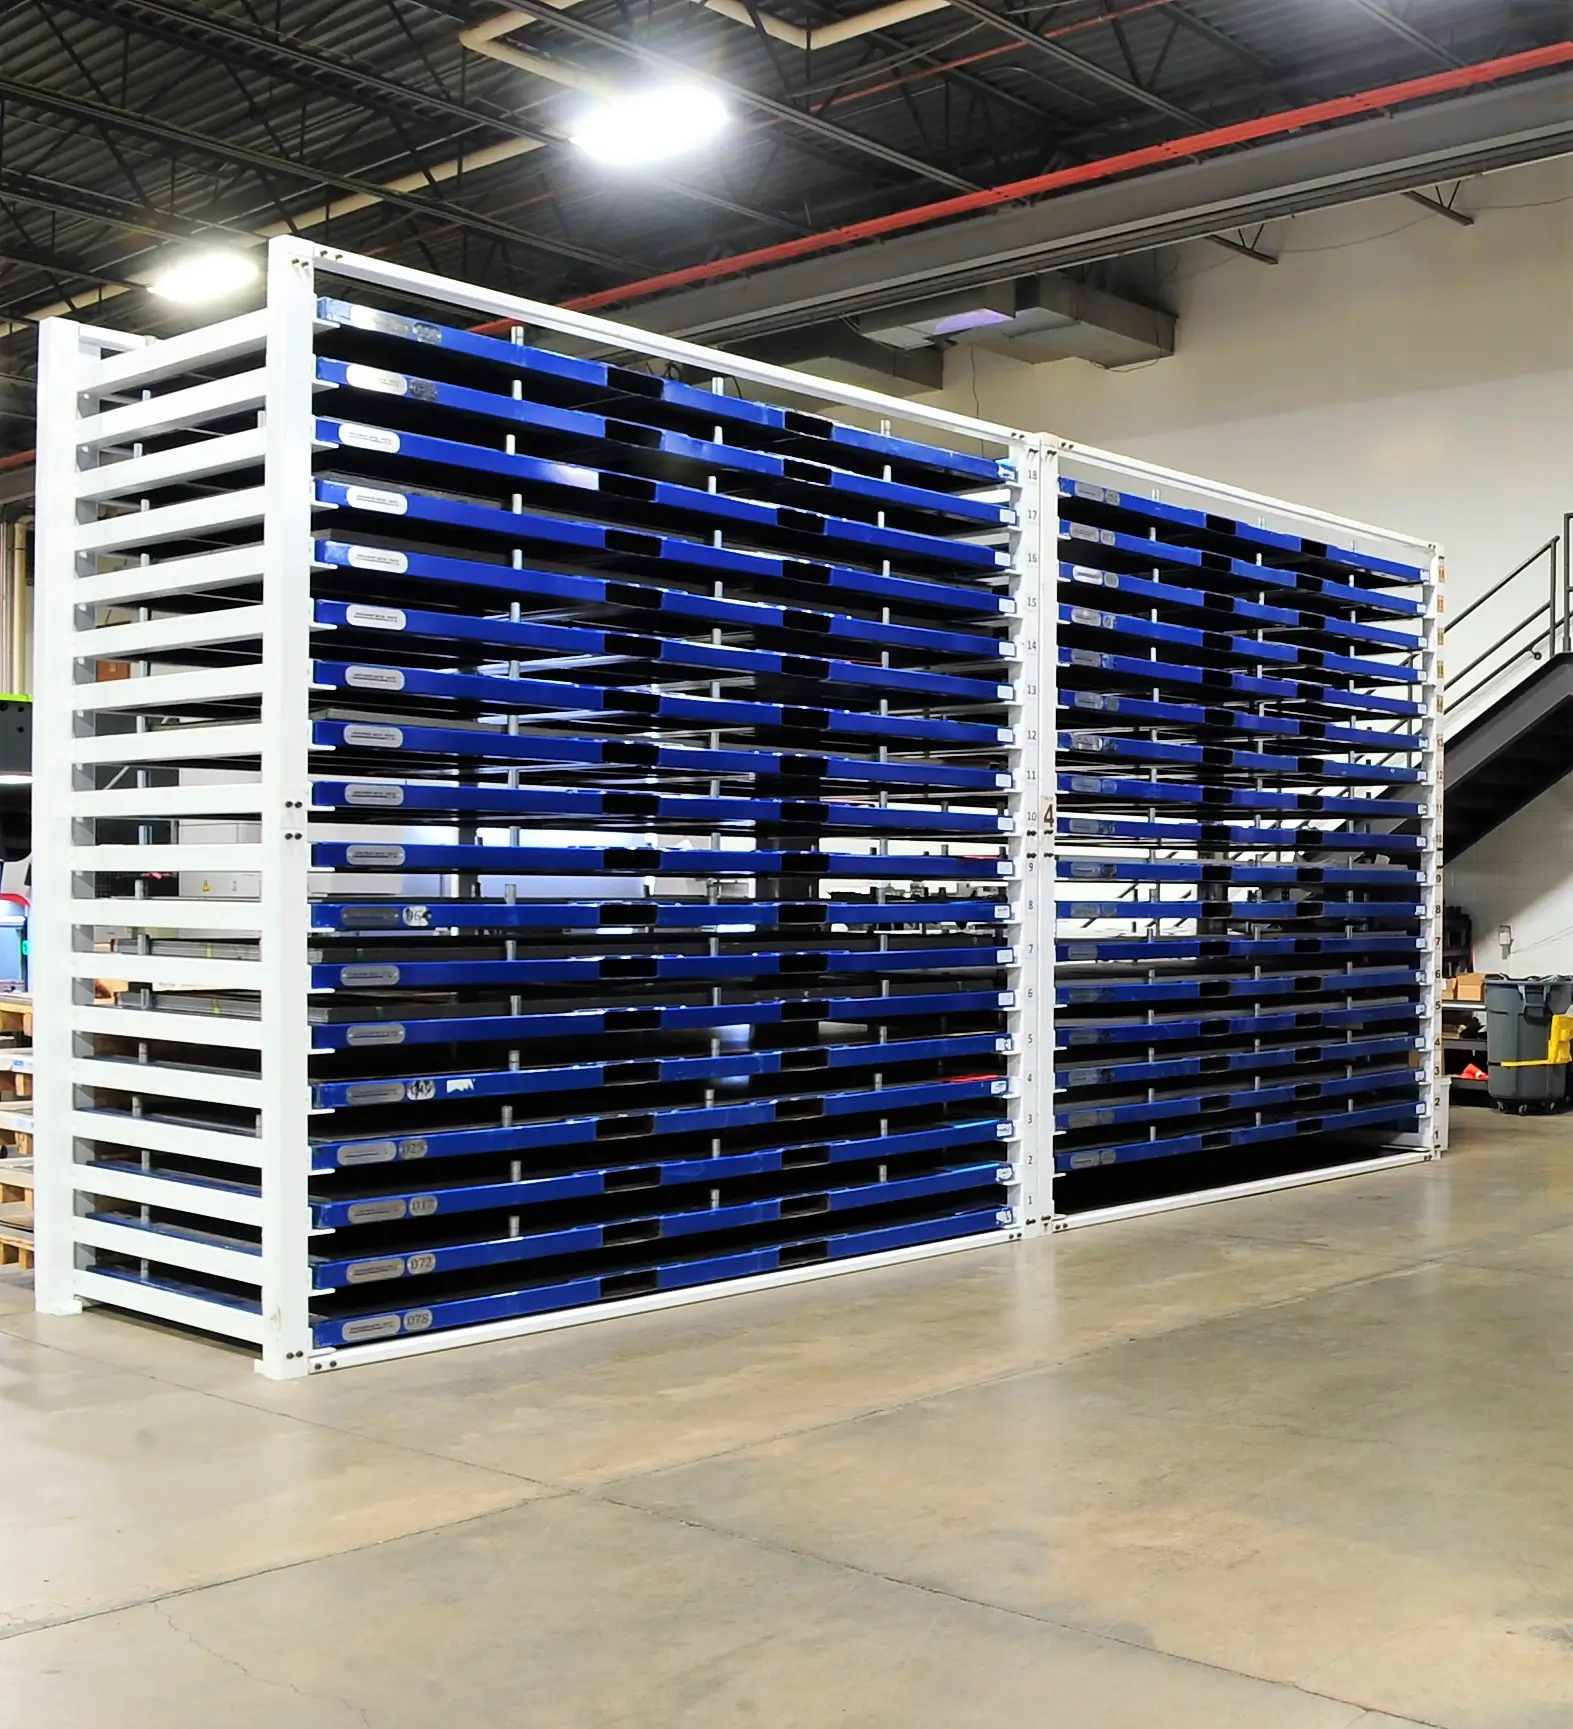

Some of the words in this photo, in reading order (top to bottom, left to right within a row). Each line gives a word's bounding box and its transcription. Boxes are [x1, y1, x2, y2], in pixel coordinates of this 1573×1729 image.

[1028, 469, 1037, 480] 18
[1028, 509, 1037, 519] 17
[1028, 552, 1037, 563] 16
[1027, 596, 1037, 607] 15
[1027, 640, 1037, 650] 14
[1027, 684, 1037, 695] 13
[1027, 730, 1037, 740] 12
[1026, 770, 1036, 780] 11
[1027, 811, 1037, 822] 10
[1043, 803, 1055, 828] 4
[1028, 862, 1034, 872] 9
[1028, 900, 1034, 910] 8
[1028, 944, 1034, 954] 7
[1027, 988, 1033, 998] 6
[1027, 1033, 1033, 1044] 5
[1027, 1073, 1033, 1082] 4
[1028, 1113, 1033, 1124] 3
[1028, 1155, 1033, 1165] 2
[1028, 1195, 1033, 1205] 1
